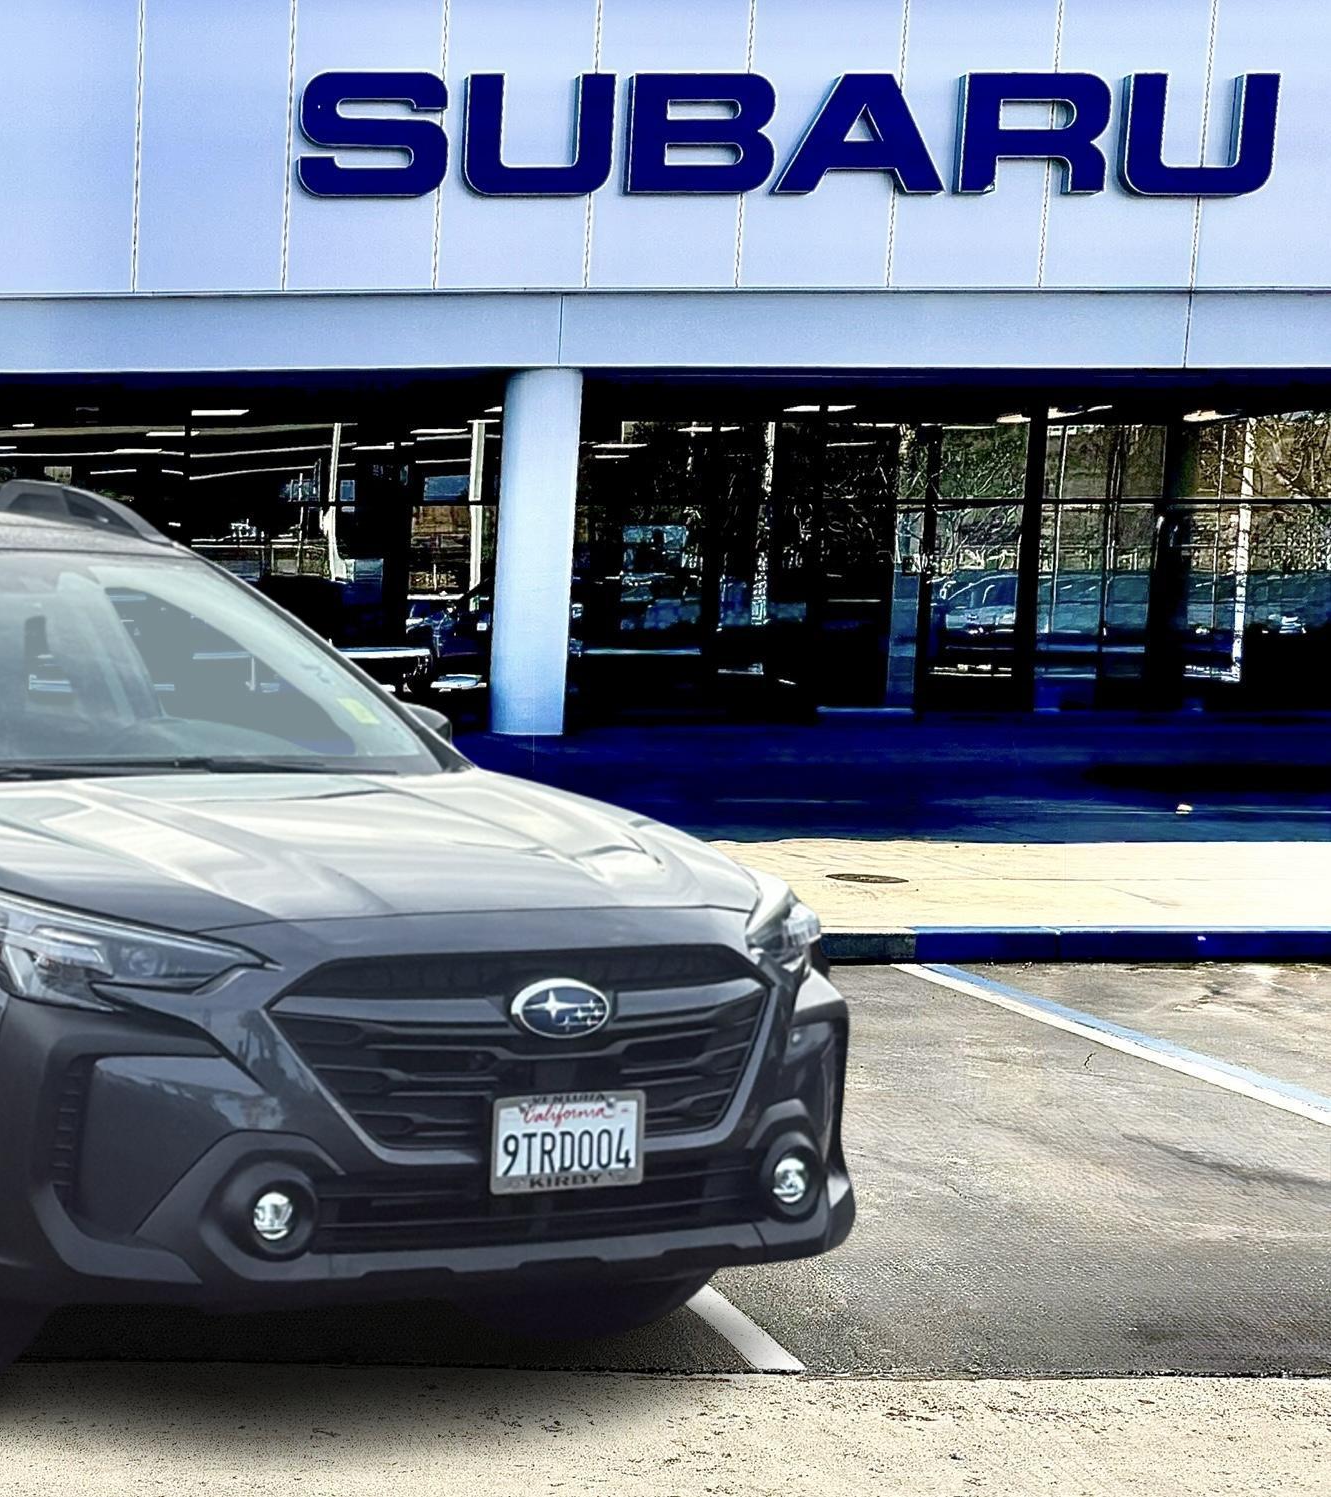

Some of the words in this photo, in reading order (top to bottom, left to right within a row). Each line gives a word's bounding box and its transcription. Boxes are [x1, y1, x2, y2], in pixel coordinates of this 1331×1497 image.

[296, 70, 1281, 198] SUBARU
[523, 1103, 615, 1128] California
[502, 1127, 632, 1177] 9TRD004
[528, 1172, 603, 1188] KIRBY
